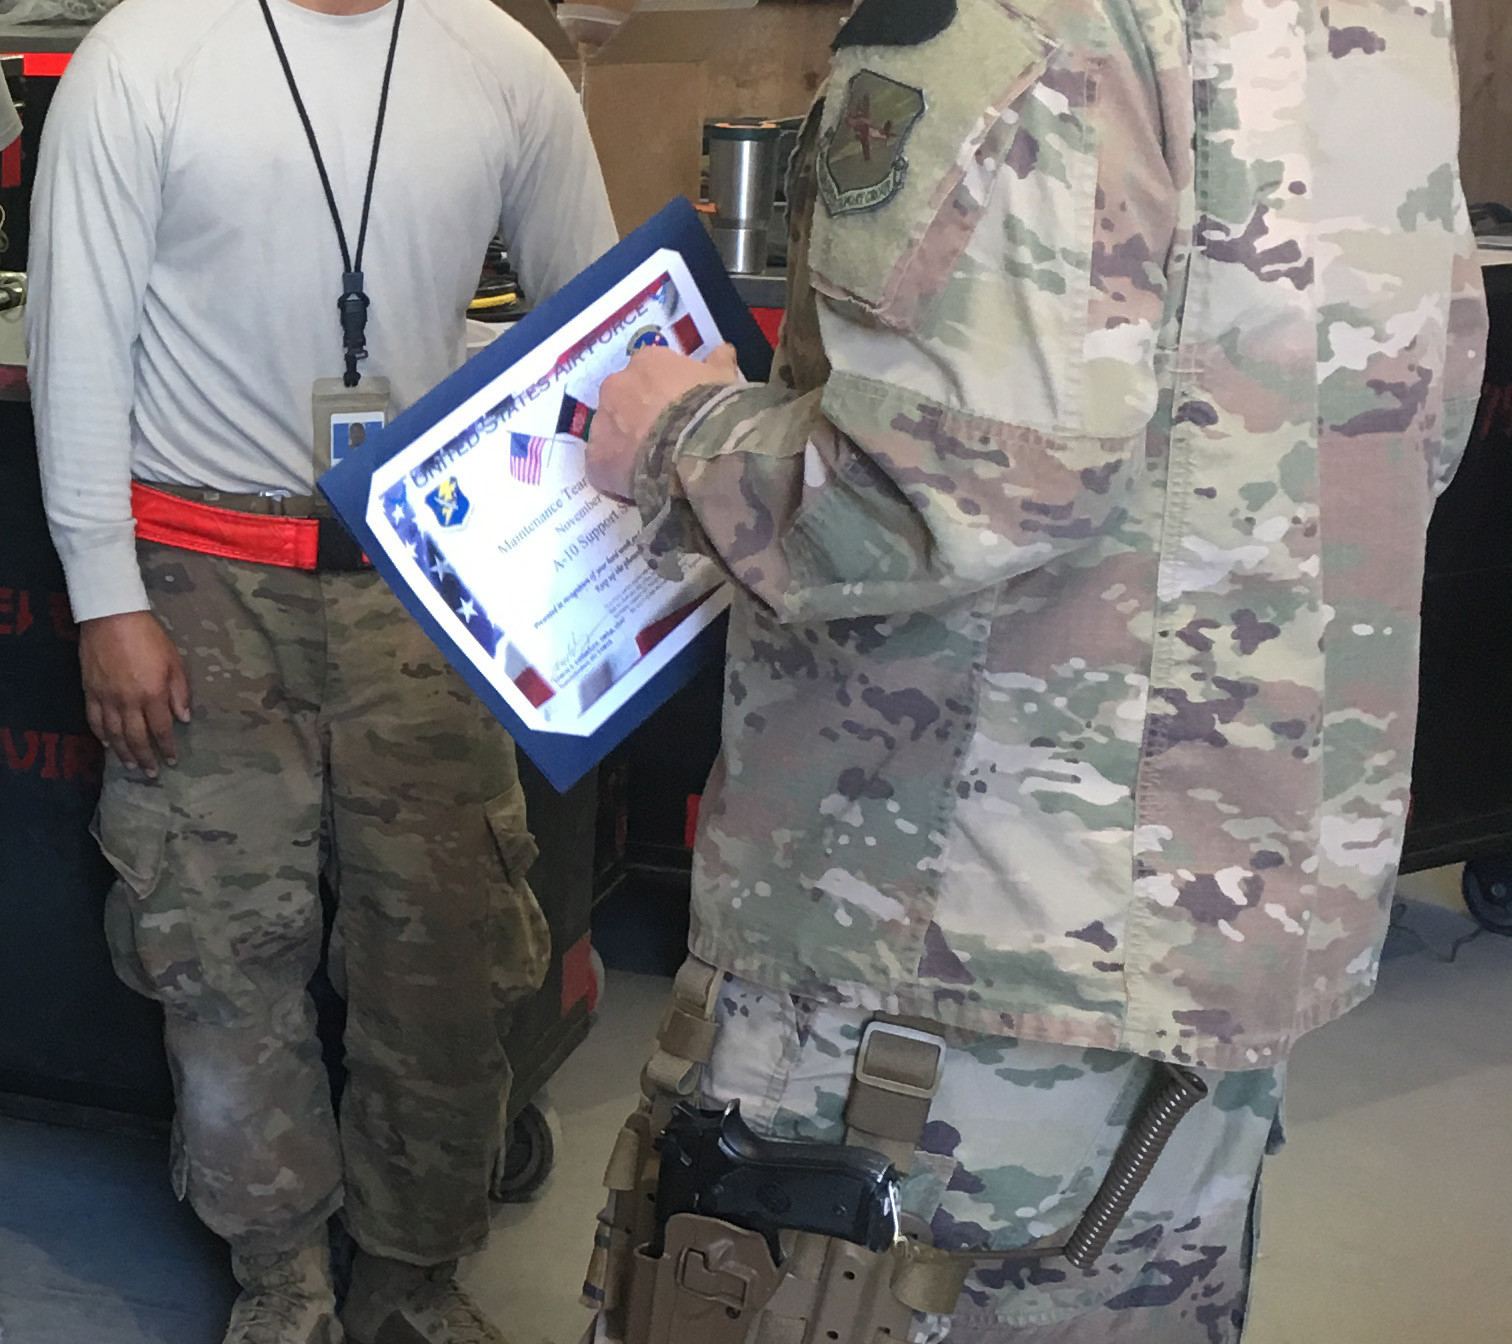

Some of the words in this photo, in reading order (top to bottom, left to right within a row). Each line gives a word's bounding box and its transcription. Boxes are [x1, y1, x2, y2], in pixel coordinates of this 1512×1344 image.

[409, 426, 480, 488] UNITED
[479, 375, 551, 435] STATES
[553, 349, 586, 383] AIR
[586, 301, 649, 356] FORCE
[497, 498, 564, 554] Maintenance
[553, 543, 580, 573] A-10
[577, 510, 620, 550] Support
[554, 495, 602, 535] November
